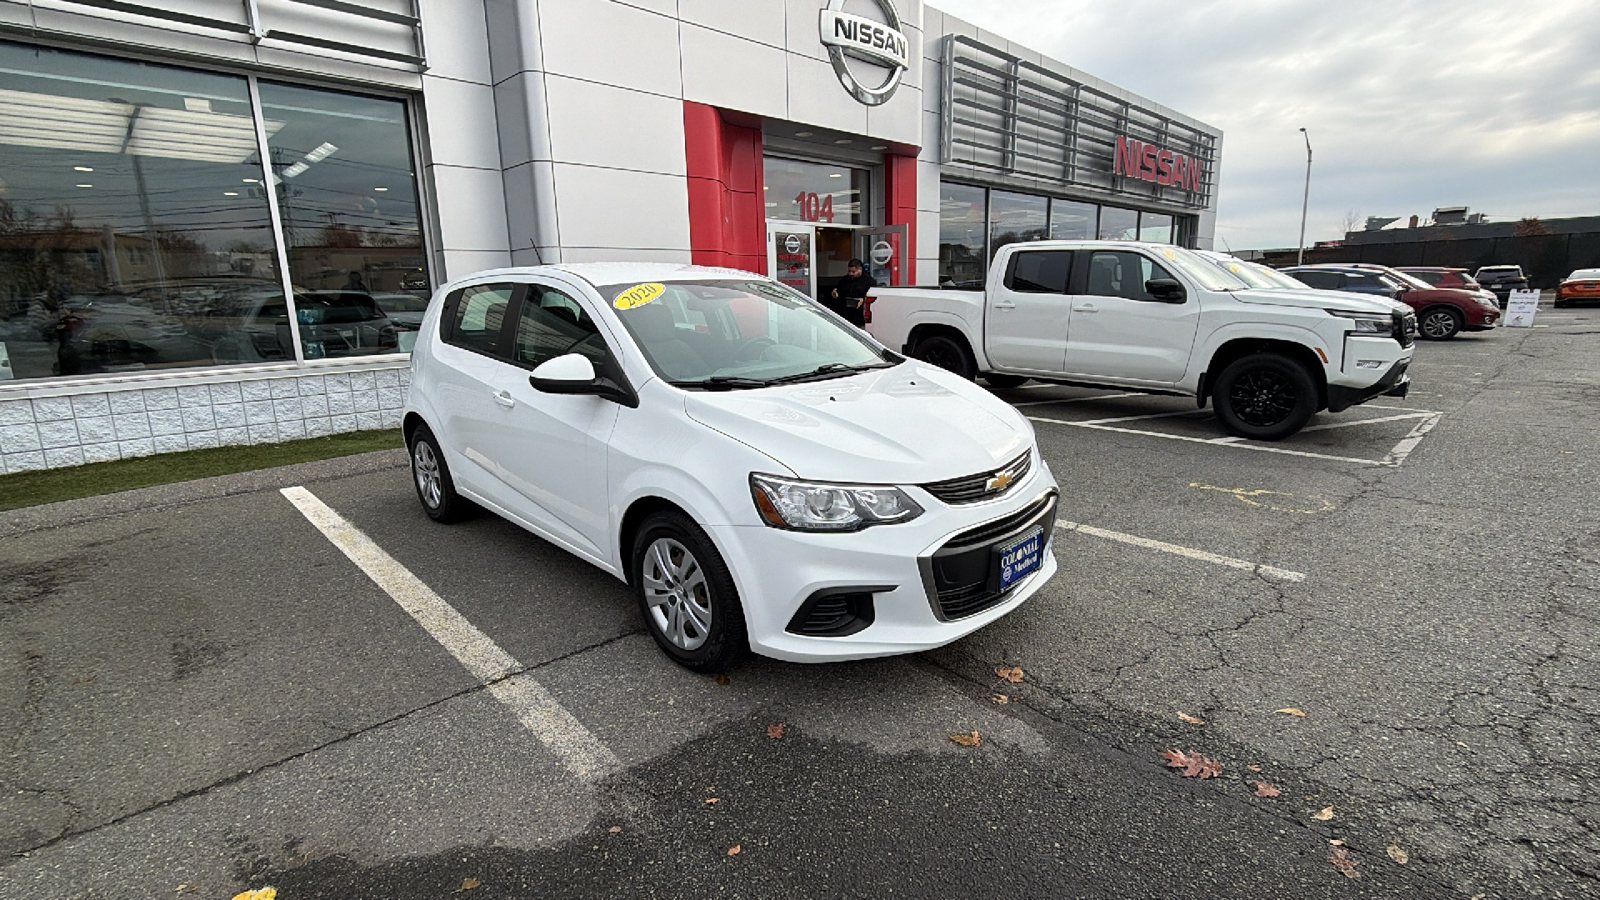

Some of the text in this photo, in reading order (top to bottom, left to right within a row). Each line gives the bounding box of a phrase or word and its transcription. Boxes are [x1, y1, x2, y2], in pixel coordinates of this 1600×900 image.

[834, 17, 907, 60] NISSAN
[1114, 134, 1203, 193] NISSAN
[794, 190, 835, 223] 104
[621, 284, 658, 307] 2020
